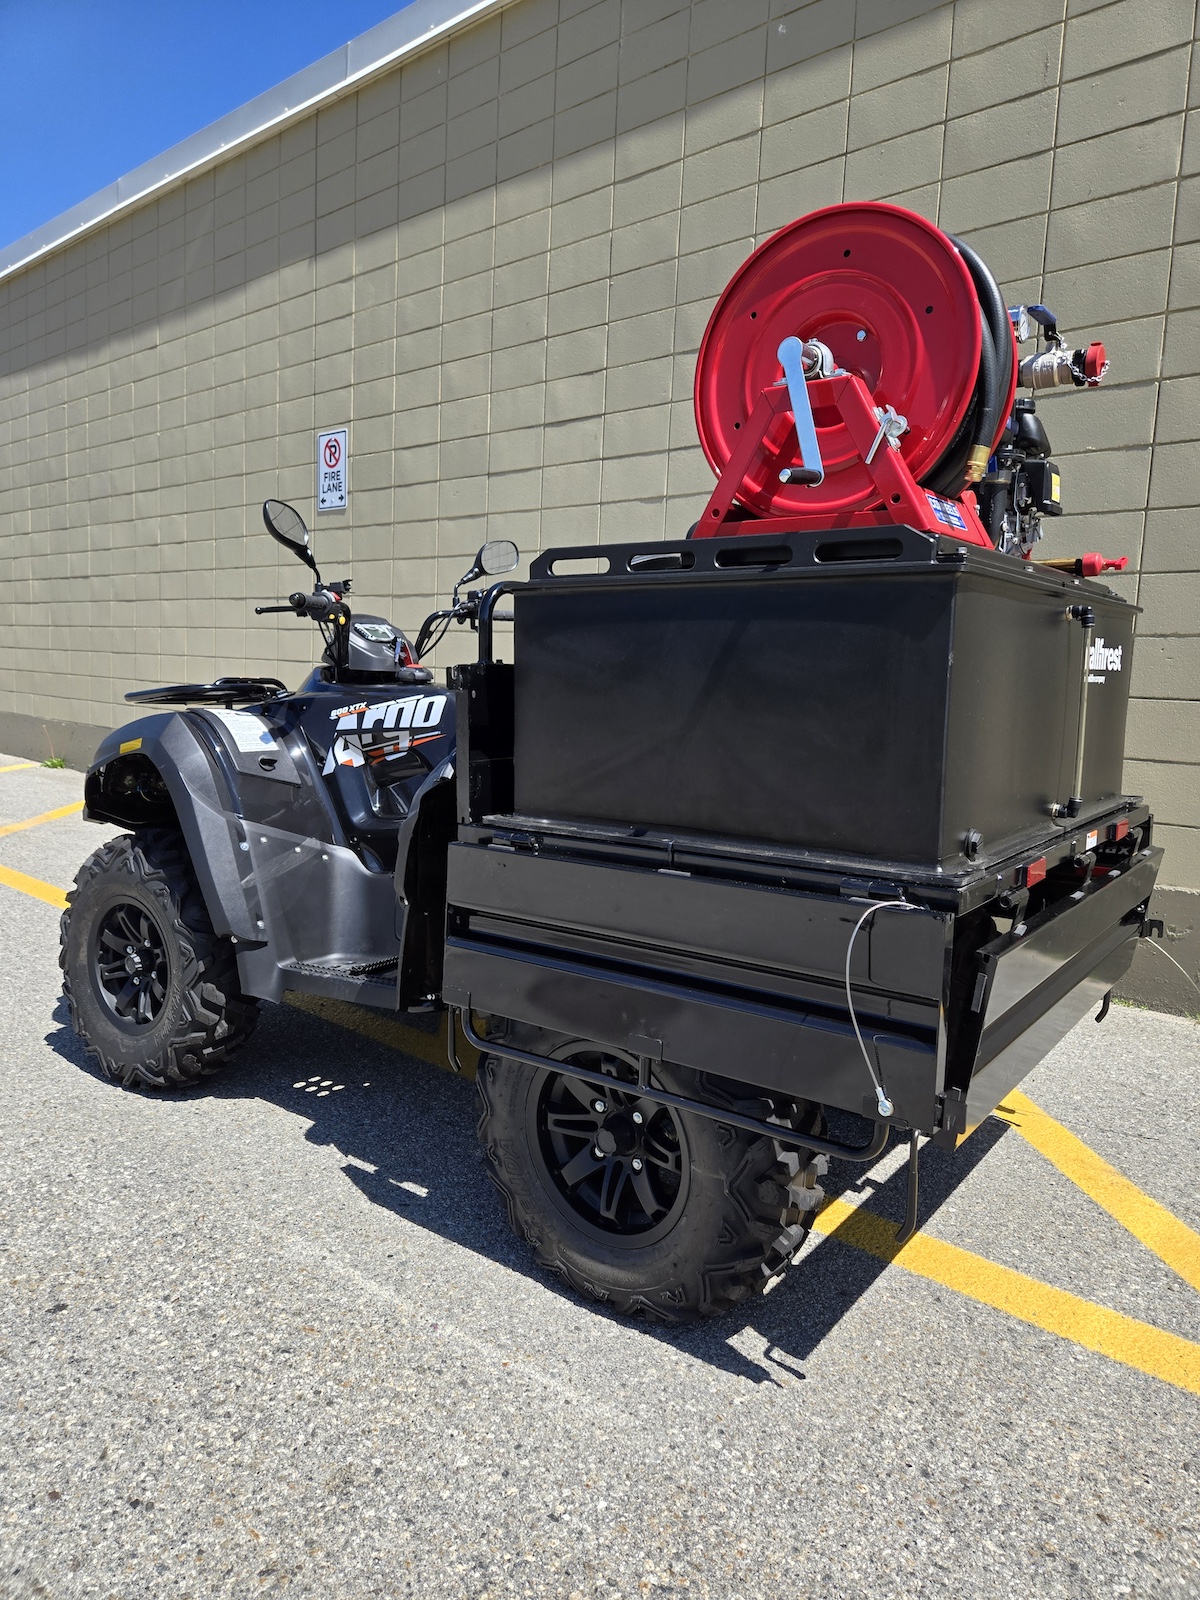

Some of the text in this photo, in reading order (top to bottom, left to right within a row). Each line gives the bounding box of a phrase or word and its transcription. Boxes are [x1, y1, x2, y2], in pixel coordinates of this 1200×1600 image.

[323, 470, 341, 482] FIRE
[322, 482, 343, 494] LANE
[330, 701, 367, 717] 600 XTX
[499, 1139, 556, 1236] KENDA
